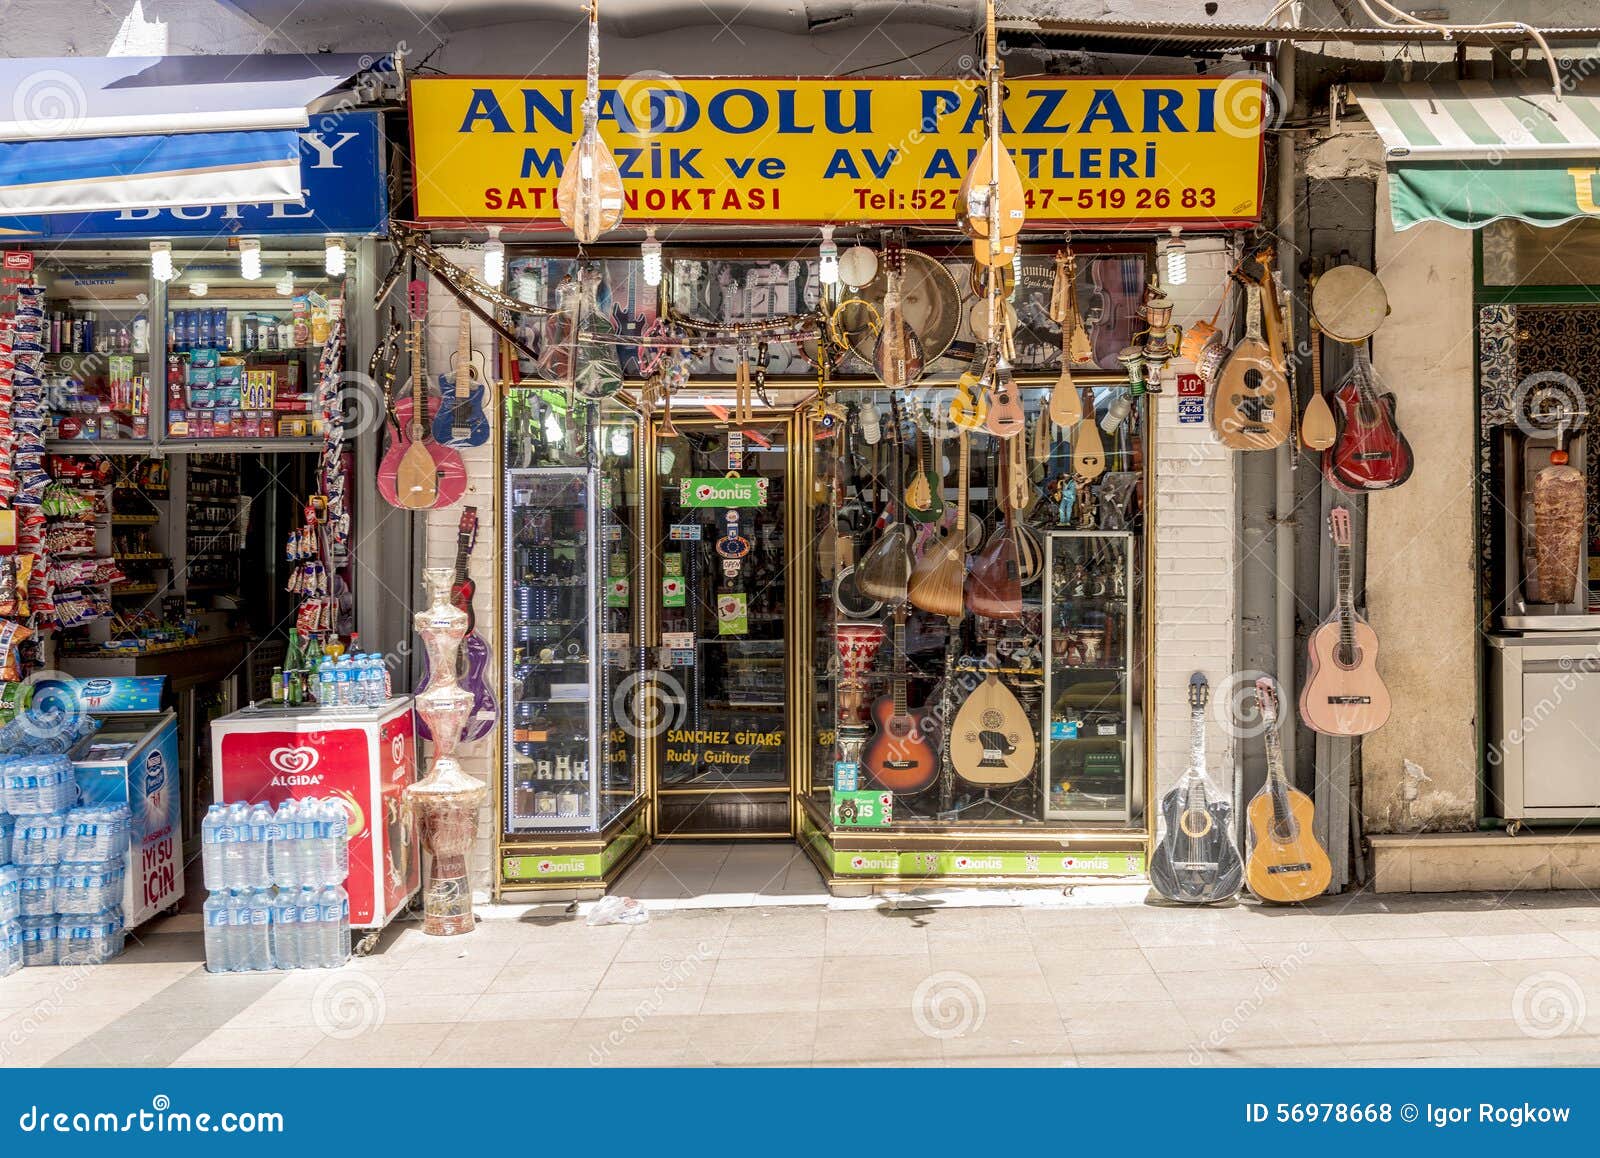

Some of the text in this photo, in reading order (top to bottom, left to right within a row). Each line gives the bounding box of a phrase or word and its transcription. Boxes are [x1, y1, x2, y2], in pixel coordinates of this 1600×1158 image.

[458, 88, 1216, 134] ANADOLU PAZARI
[520, 142, 1156, 179] MZİK ve AV ATLERİ
[485, 187, 781, 210] SATI NOKTASI
[1136, 187, 1170, 209] 26
[1181, 187, 1216, 209] 83
[724, 561, 740, 569] OPEN
[667, 729, 729, 744] SANCHEZ
[666, 749, 751, 765] Rudy Guitars
[158, 837, 173, 864] SU
